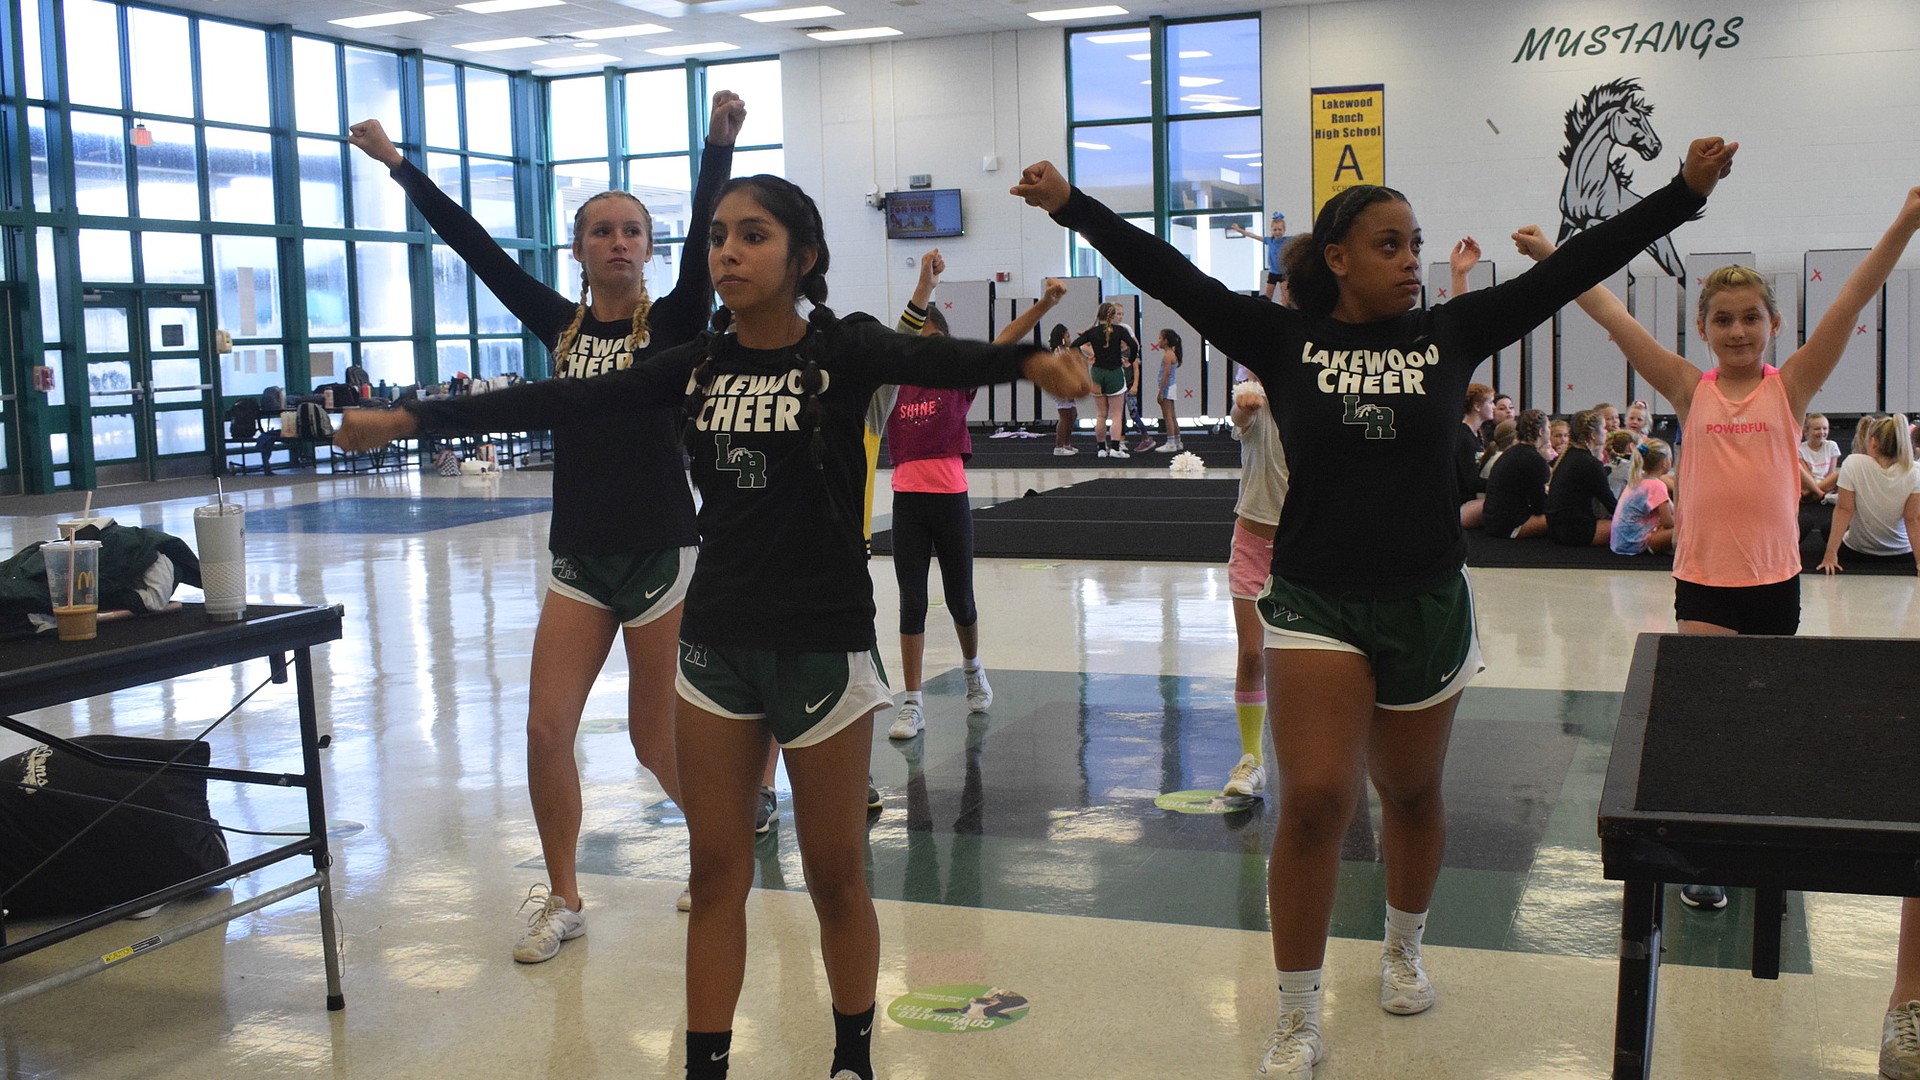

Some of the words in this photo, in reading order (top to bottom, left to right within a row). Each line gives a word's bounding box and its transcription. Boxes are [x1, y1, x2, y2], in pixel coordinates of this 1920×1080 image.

[1512, 16, 1744, 63] MUSTANGS
[1322, 97, 1373, 110] Lakewood
[1331, 112, 1364, 124] Ranch
[1315, 128, 1340, 140] High
[1343, 126, 1381, 138] School
[1333, 144, 1364, 182] A
[1302, 341, 1439, 375] LAKEWOOD
[1317, 368, 1426, 395] CHEER
[696, 395, 801, 432] CHEER
[900, 401, 936, 418] SHINE
[1706, 422, 1769, 434] POWERFUL
